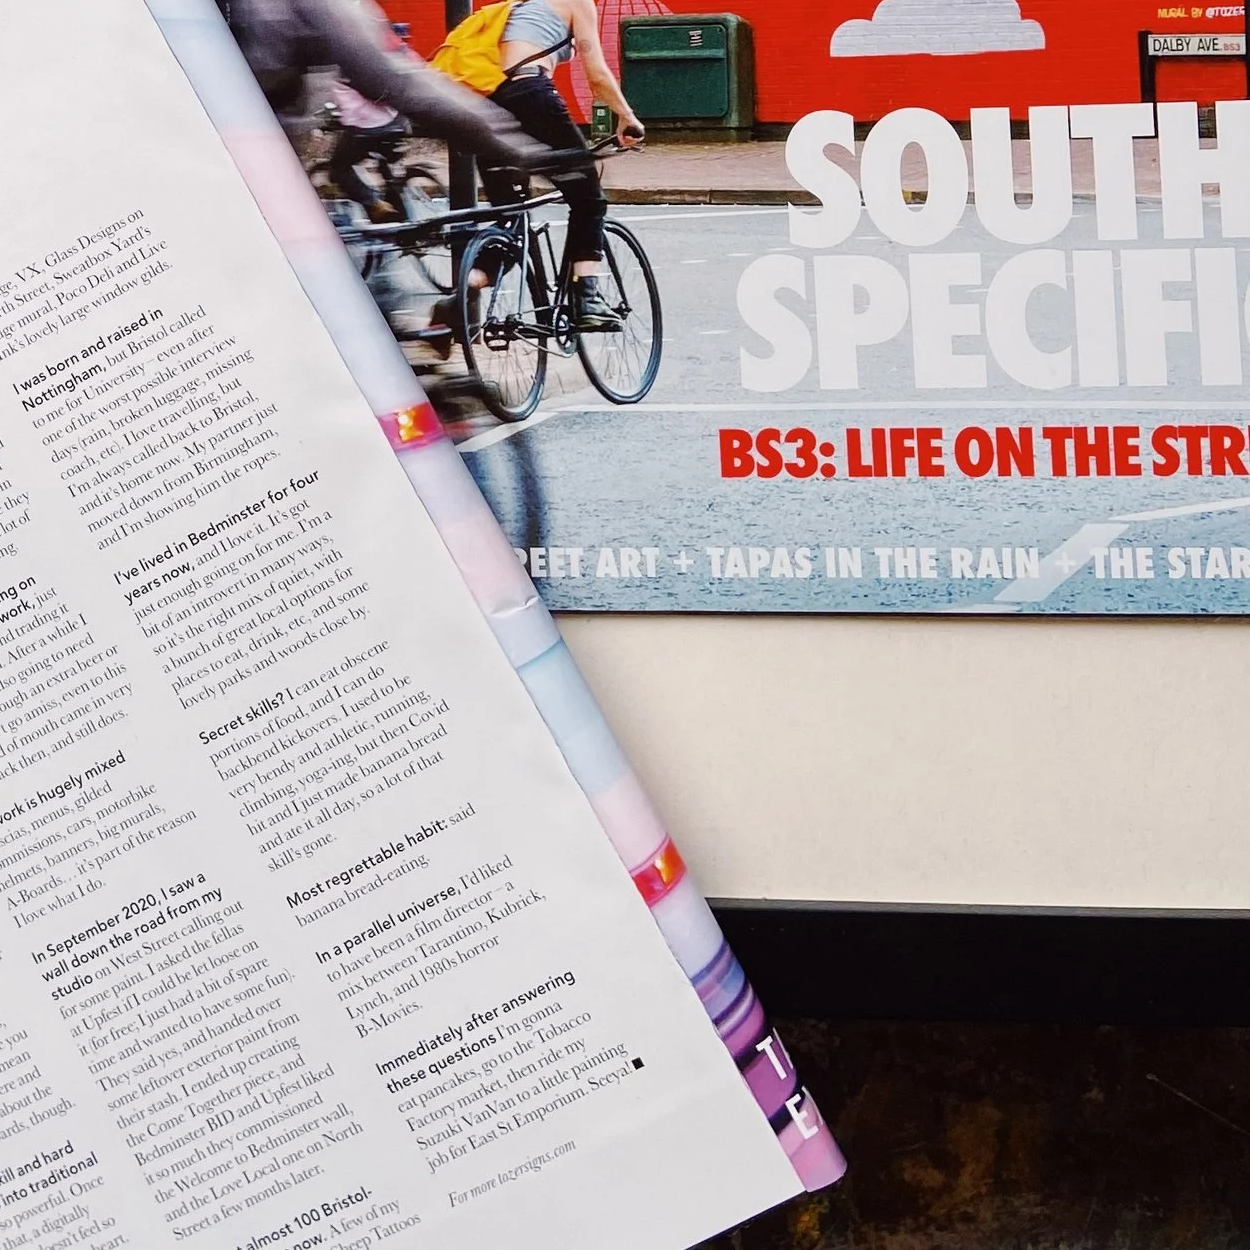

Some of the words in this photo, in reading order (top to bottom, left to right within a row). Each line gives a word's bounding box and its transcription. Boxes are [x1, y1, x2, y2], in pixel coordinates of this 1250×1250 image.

[1153, 38, 1191, 52] DALBY
[1157, 8, 1189, 18] MURAL
[1191, 8, 1203, 18] BY
[785, 101, 1250, 248] SOUTH
[11, 383, 21, 396] I
[20, 372, 47, 391] was
[45, 355, 79, 376] born
[81, 336, 106, 359] and
[107, 313, 149, 344] raised
[147, 308, 165, 322] in
[22, 364, 106, 412] Nottingham,
[105, 351, 128, 366] but
[127, 325, 168, 355] Bristol
[170, 305, 206, 333] called
[736, 249, 1250, 392] SPECIFI
[719, 427, 836, 479] BS3:
[847, 427, 945, 478] LIFE
[954, 426, 1035, 478] ON
[1043, 426, 1142, 476] THE
[1152, 425, 1250, 476] STR
[138, 545, 174, 572] lived
[172, 541, 189, 555] in
[187, 499, 266, 546] Bedminster
[267, 487, 288, 504] for
[290, 470, 319, 492] four
[596, 547, 660, 578] ART
[706, 547, 812, 578] TAPAS
[826, 547, 863, 578] IN
[874, 547, 938, 579] THE
[950, 547, 1040, 579] RAIN
[1092, 547, 1155, 579] THE
[17, 576, 37, 591] on
[23, 798, 39, 811] is
[36, 775, 83, 804] hugely
[85, 749, 126, 780] mixed
[286, 882, 325, 909] Most
[325, 842, 405, 889] regrettable
[404, 820, 448, 847] habit:
[450, 802, 476, 825] said
[30, 951, 47, 965] In
[46, 914, 120, 957] September
[122, 894, 161, 920] 2020,
[159, 887, 169, 901] I
[169, 878, 194, 897] saw
[196, 872, 207, 884] a
[375, 1026, 463, 1075] Immediately
[465, 1007, 498, 1032] after
[502, 971, 575, 1013] answering
